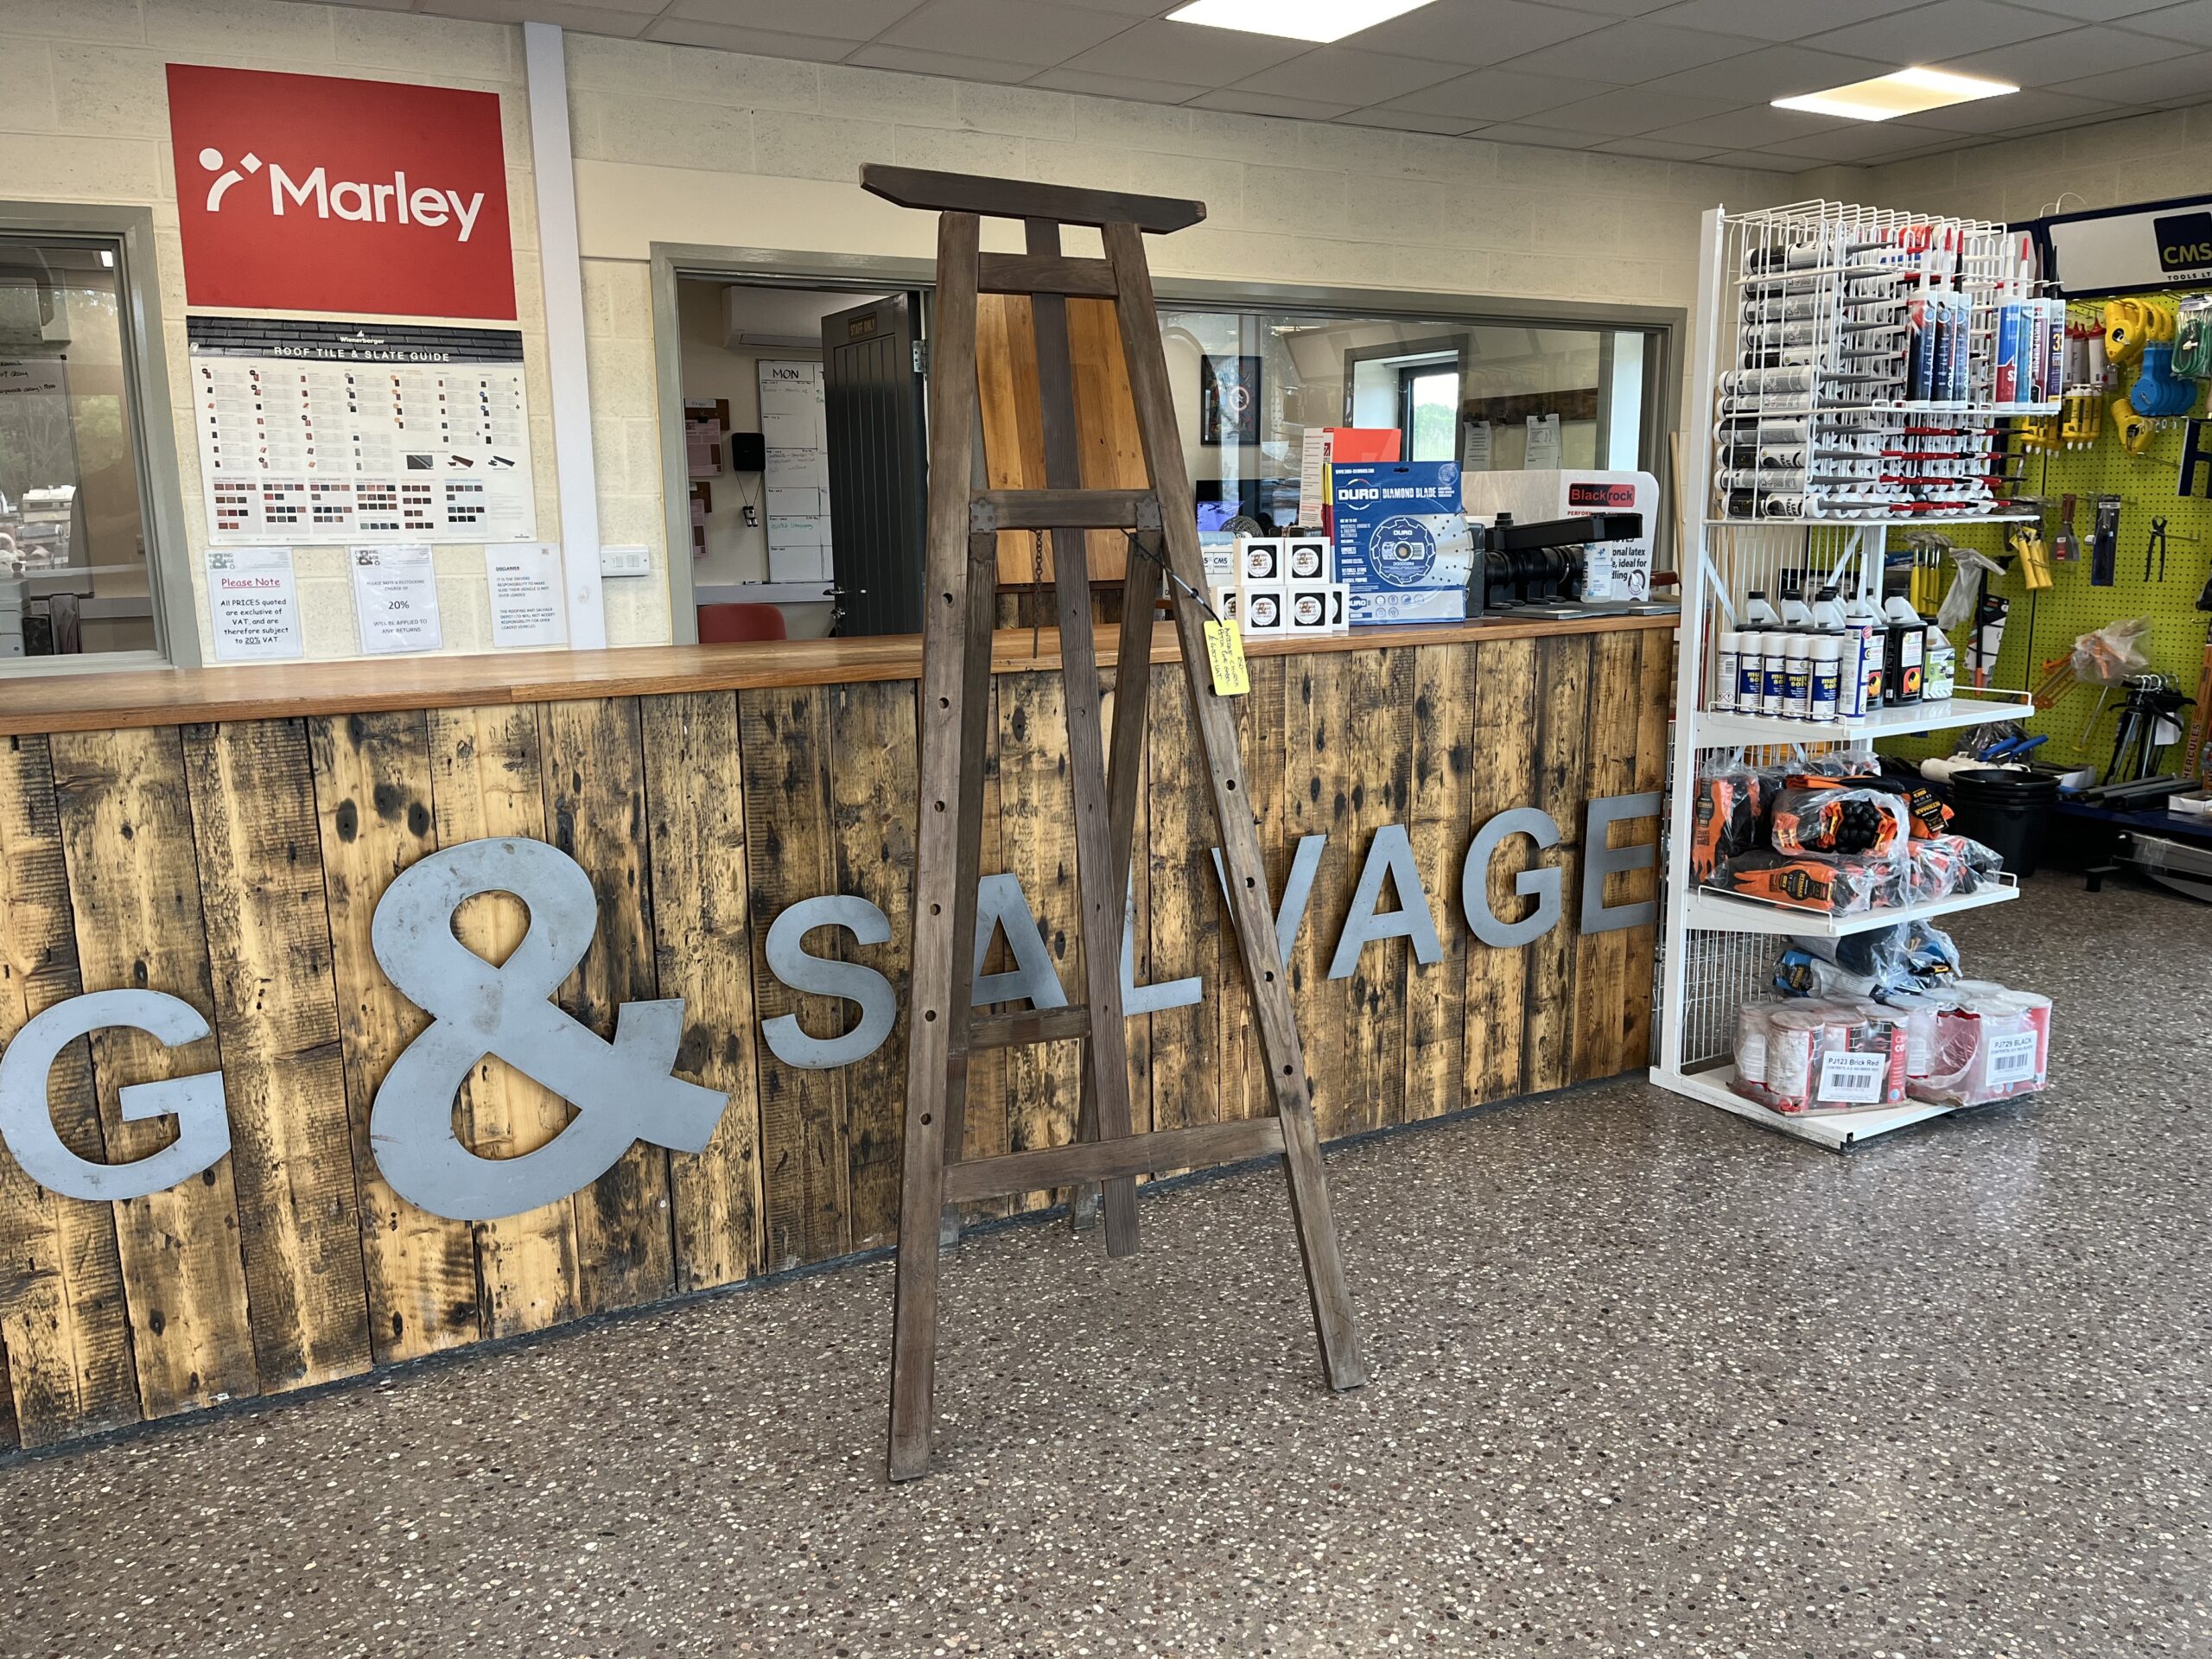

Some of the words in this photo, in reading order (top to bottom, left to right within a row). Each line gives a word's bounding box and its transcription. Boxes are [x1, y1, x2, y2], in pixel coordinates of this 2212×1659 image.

[269, 163, 485, 242] Marley
[2163, 243, 2212, 264] CMS
[340, 336, 385, 345] Wienerberger
[274, 347, 309, 357] ROOF
[316, 348, 345, 358] TILE
[351, 349, 359, 358] &
[365, 350, 404, 359] SLATE
[410, 352, 449, 362] GUIDE
[772, 368, 799, 379] MON
[1338, 488, 1379, 500] DURO
[1382, 487, 1414, 499] DIAMOND
[1415, 486, 1437, 499] BLADE
[1571, 488, 1633, 501] Blackrock
[1629, 547, 1646, 556] latex
[1618, 558, 1637, 569] ideal
[1637, 558, 1647, 569] for
[221, 578, 253, 587] Please
[255, 577, 281, 587] Note
[388, 601, 410, 610] 20%
[262, 626, 289, 635] subject
[1789, 674, 1808, 683] mult
[2183, 723, 2201, 779] HERCULES
[371, 836, 729, 1220] &
[761, 791, 1661, 1070] SALVAGE
[2014, 1037, 2032, 1046] BLACK
